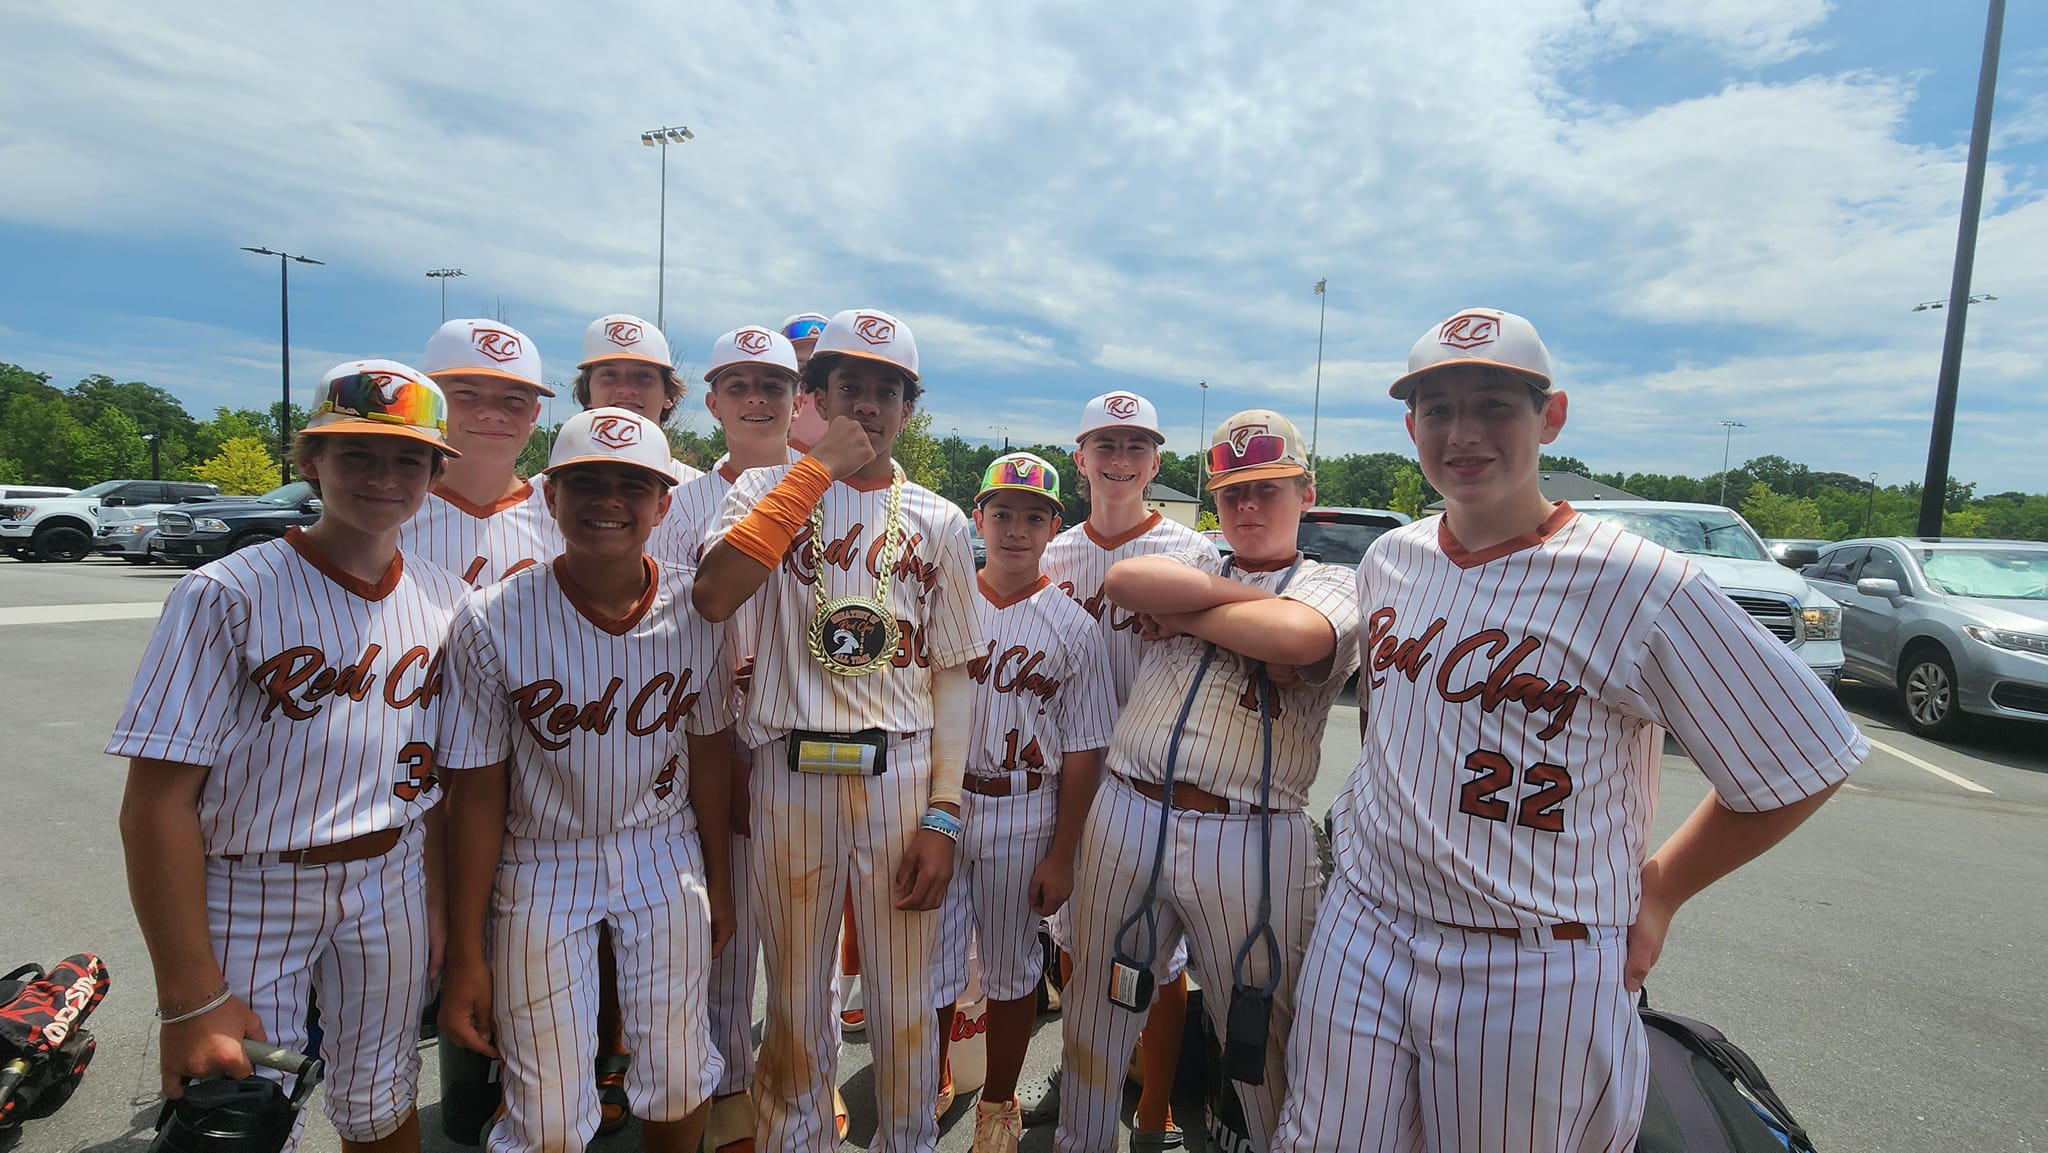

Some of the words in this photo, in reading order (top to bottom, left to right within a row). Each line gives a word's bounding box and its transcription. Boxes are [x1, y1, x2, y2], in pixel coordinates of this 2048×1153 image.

[608, 324, 637, 341] RC
[738, 332, 766, 349] RC
[858, 319, 890, 340] RC
[1444, 318, 1492, 343] RC
[478, 333, 515, 356] RC
[1107, 398, 1134, 414] RC
[594, 419, 635, 442] RC
[250, 643, 382, 722] Red
[993, 645, 1060, 715] Clay
[1369, 606, 1447, 690] Red
[1436, 628, 1587, 741] Clay
[511, 677, 623, 751] Red
[1459, 748, 1573, 833] 22
